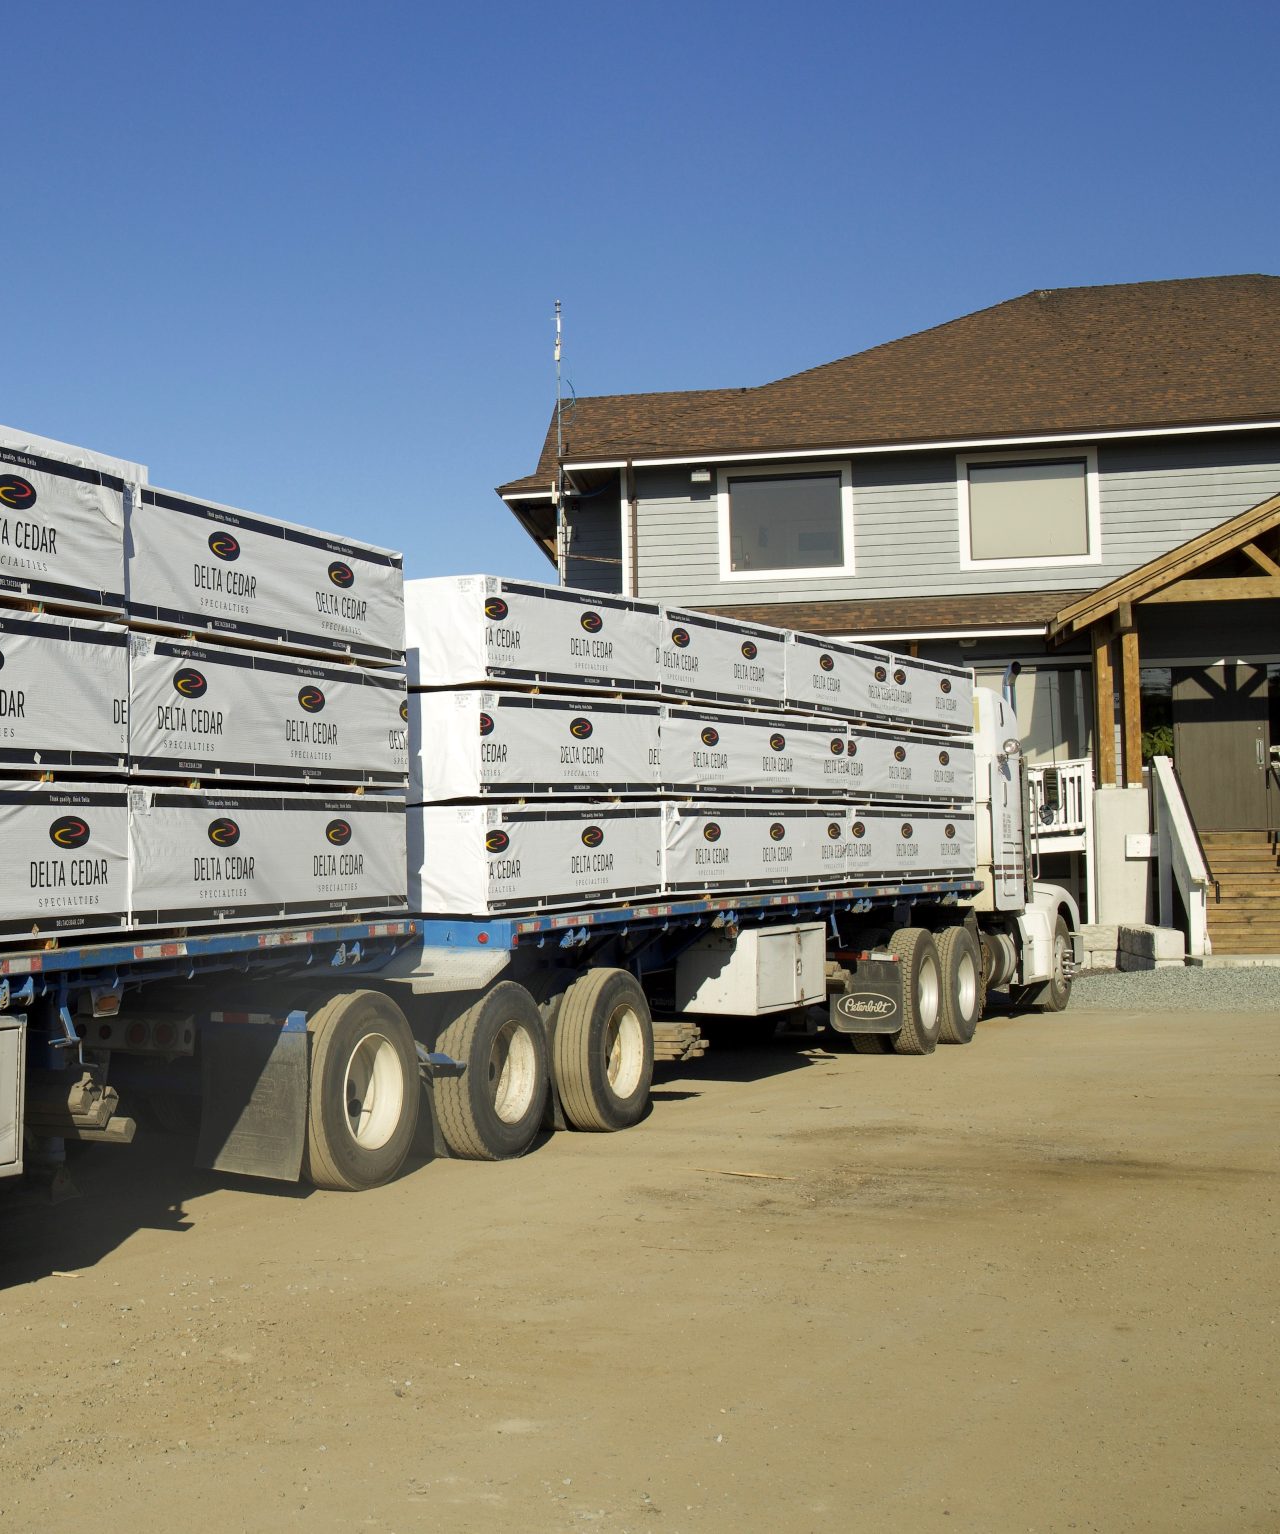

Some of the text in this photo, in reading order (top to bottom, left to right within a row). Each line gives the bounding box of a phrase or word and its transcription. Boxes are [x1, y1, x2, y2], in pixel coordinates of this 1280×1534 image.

[17, 456, 26, 464] think
[15, 521, 57, 554] CEDAR
[194, 564, 256, 599] DELTA CEDAR
[201, 598, 249, 614] SPECIALTIES
[315, 591, 366, 621] DELTA CEDAR
[497, 629, 520, 649] CEDAR
[570, 638, 612, 659] DELTA CEDAR
[664, 651, 698, 672] DELTA CEDAR
[734, 664, 764, 682] DELTA CEDAR
[158, 706, 223, 735] DELTA CEDAR
[286, 719, 337, 745] DELTA CEDAR
[164, 740, 214, 751] SPECIALTIES
[481, 744, 507, 762] CEDAR
[291, 750, 332, 761] SPECIALTIES
[561, 746, 604, 764] DELTA CEDAR
[693, 752, 728, 769] DELTA CEDAR
[763, 757, 793, 772] DELTA CEDAR
[571, 854, 613, 873] DELTA CEDAR
[696, 849, 728, 864] DELTA CEDAR
[763, 847, 792, 862] DELTA CEDAR
[31, 859, 108, 888] DELTA CEDAR
[194, 857, 255, 881] DELTA CEDAR
[313, 854, 363, 876] DELTA CEDAR
[497, 860, 520, 878] CEDAR
[200, 888, 247, 898] SPECIALTIES
[318, 883, 357, 893] SPECIALTIES
[39, 896, 99, 907] SPECIALTIES
[845, 999, 890, 1013] Peterbilt
